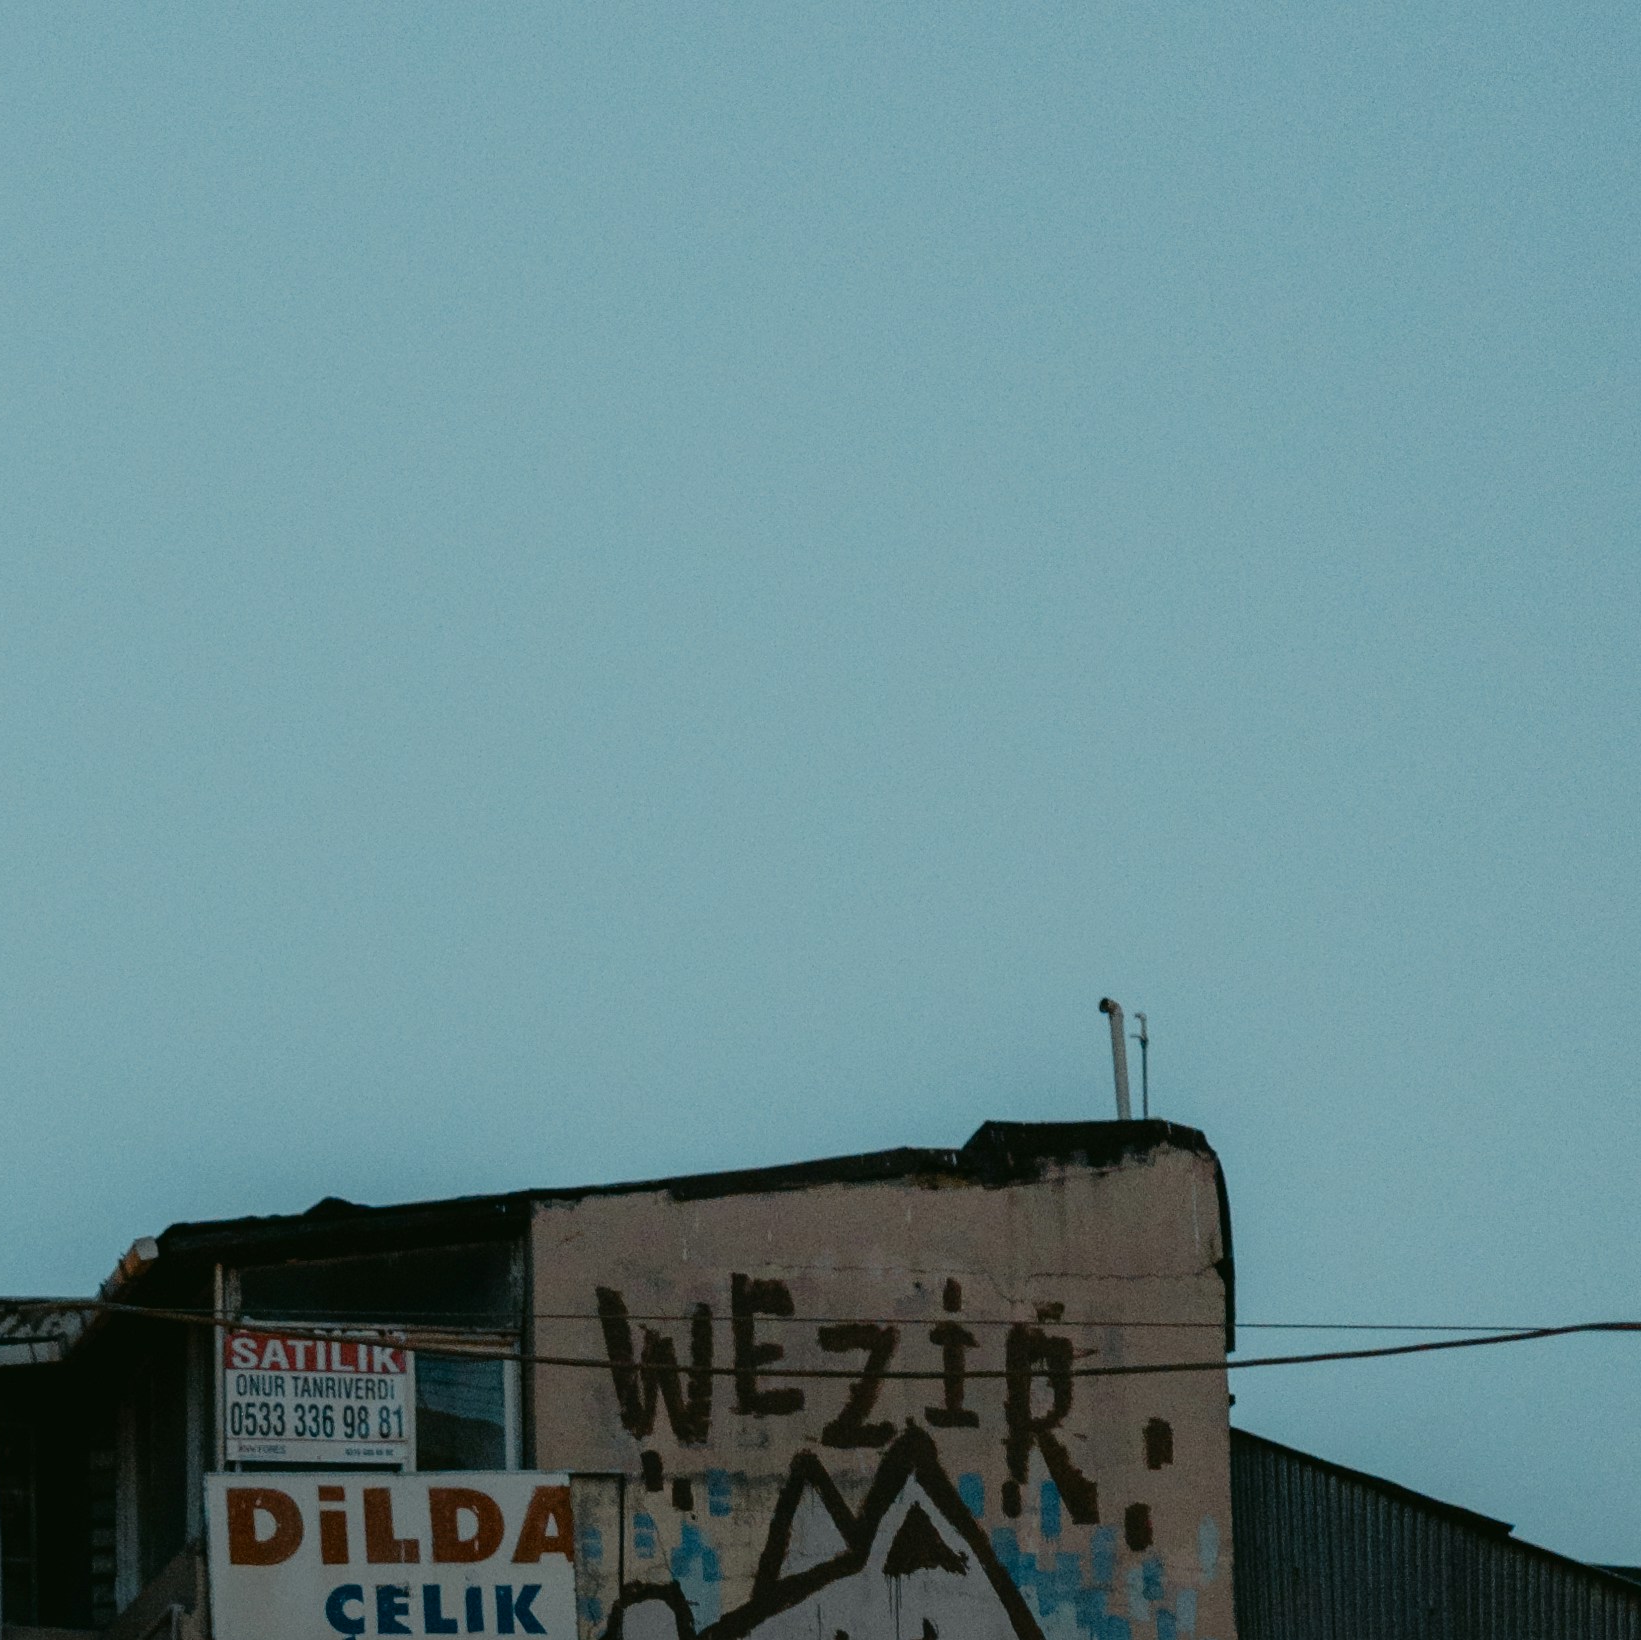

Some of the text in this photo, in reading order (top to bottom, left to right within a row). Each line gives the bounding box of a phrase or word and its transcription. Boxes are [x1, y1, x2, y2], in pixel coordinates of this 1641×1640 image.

[231, 1335, 401, 1373] SATILIK
[236, 1373, 285, 1397] ONUR
[230, 1402, 404, 1439] 0533 336 98 81
